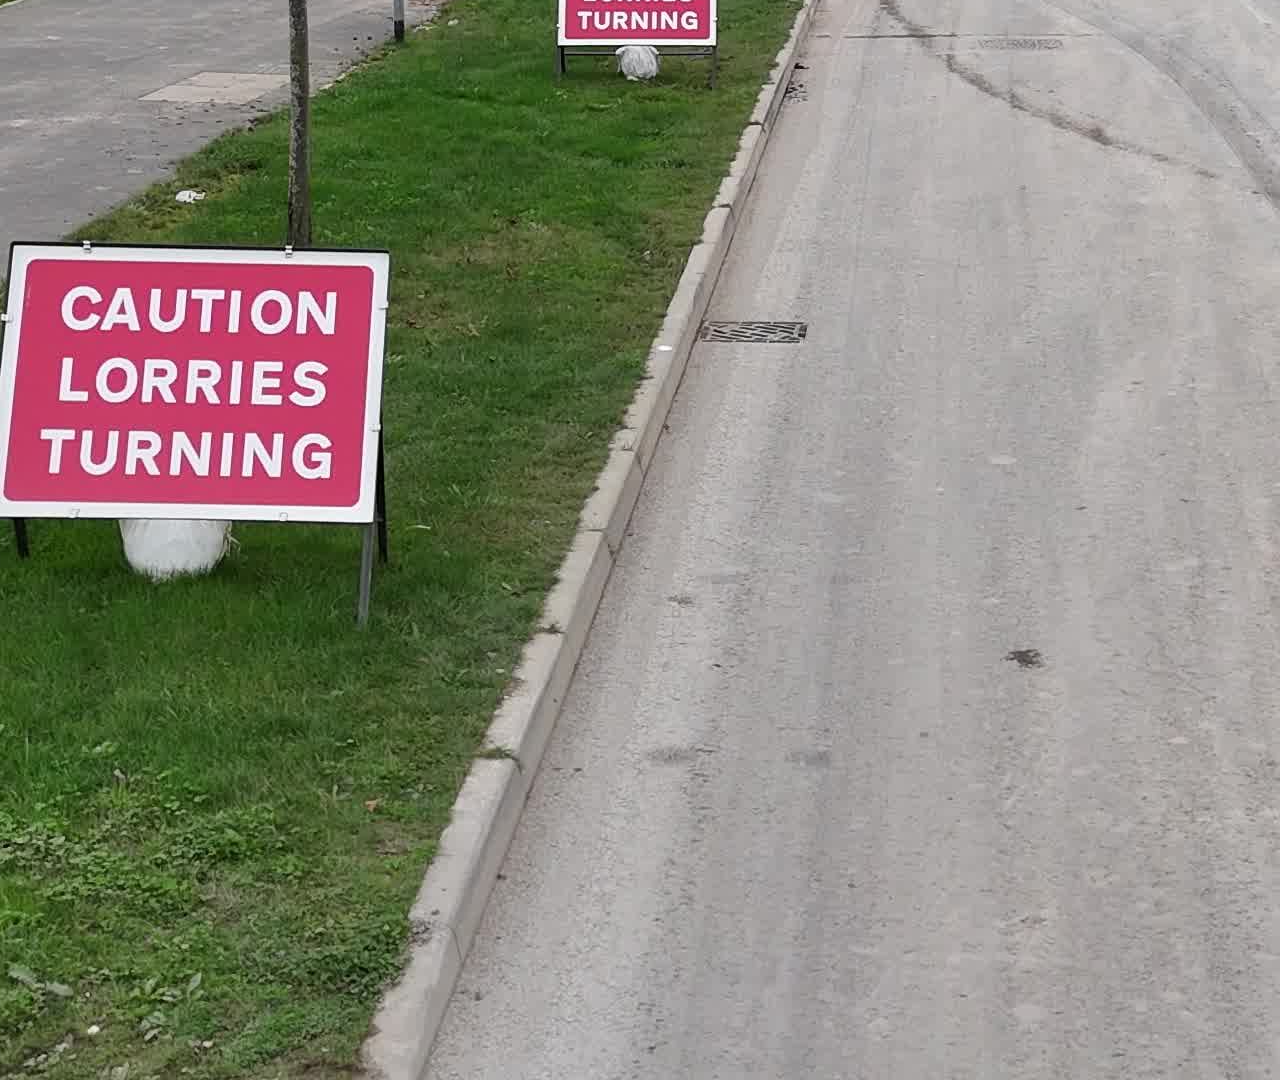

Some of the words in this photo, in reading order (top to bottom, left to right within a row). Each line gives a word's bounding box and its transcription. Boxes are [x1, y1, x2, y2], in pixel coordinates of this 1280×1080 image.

[576, 11, 699, 30] TURNING
[61, 285, 337, 335] CAUTION
[58, 357, 329, 406] LORRIES
[40, 428, 333, 479] TURNING
